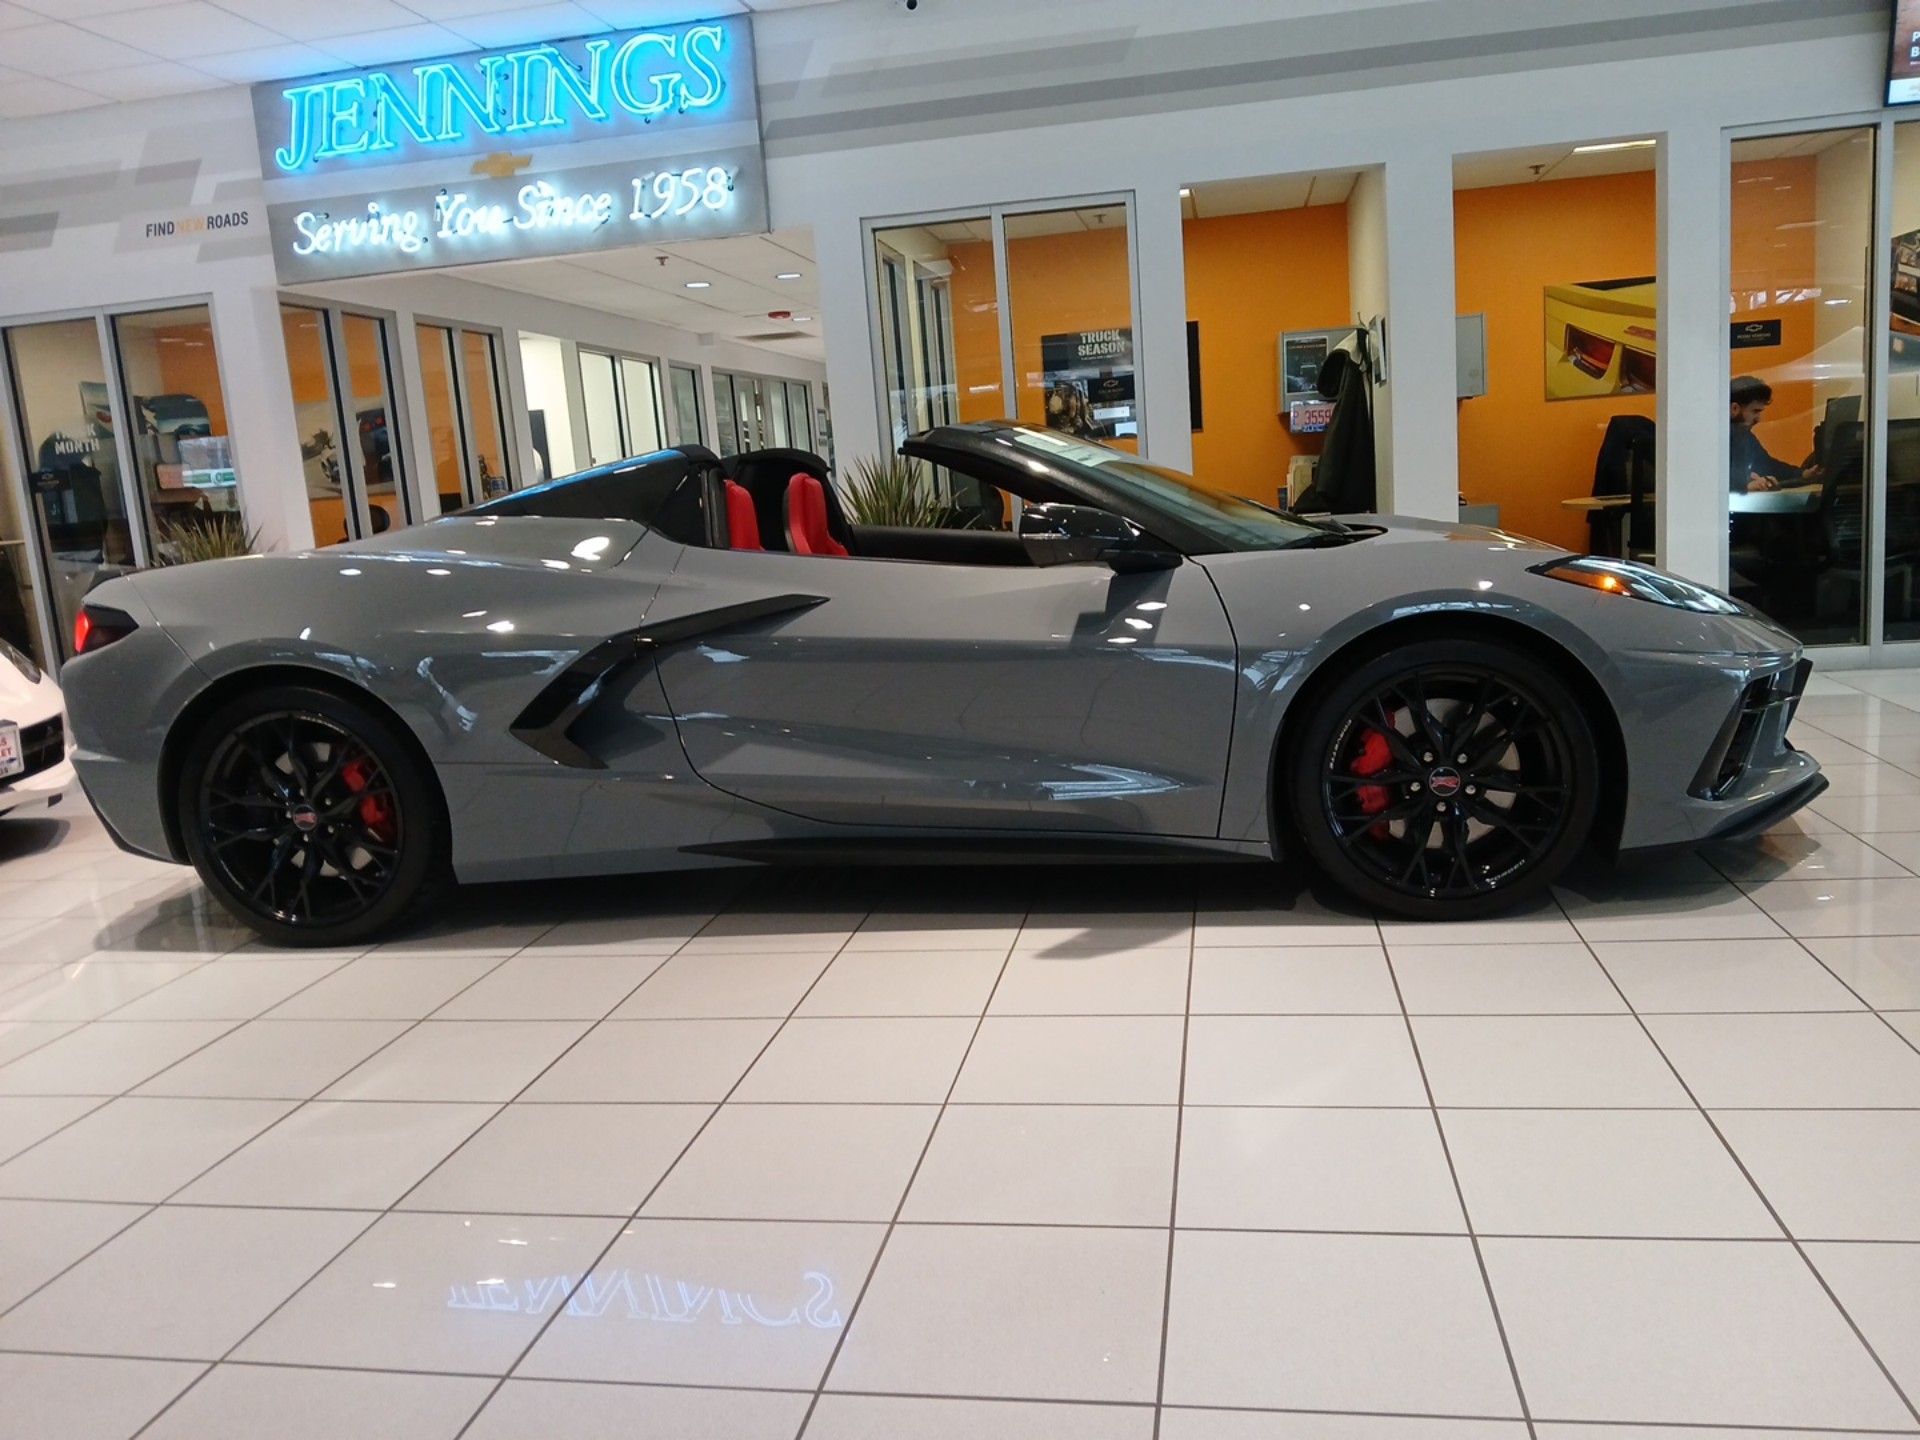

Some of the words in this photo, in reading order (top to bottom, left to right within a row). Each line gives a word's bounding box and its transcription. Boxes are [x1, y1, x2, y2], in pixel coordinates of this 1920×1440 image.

[275, 25, 722, 171] JENNINGS
[293, 203, 422, 255] Serving
[436, 194, 502, 239] You
[513, 181, 611, 231] Since
[629, 166, 730, 221] 1958
[145, 221, 175, 238] FIND
[207, 211, 249, 230] ROADS
[1080, 329, 1121, 344] TRUCK
[1078, 341, 1125, 357] SEASON
[55, 438, 100, 455] MONTH
